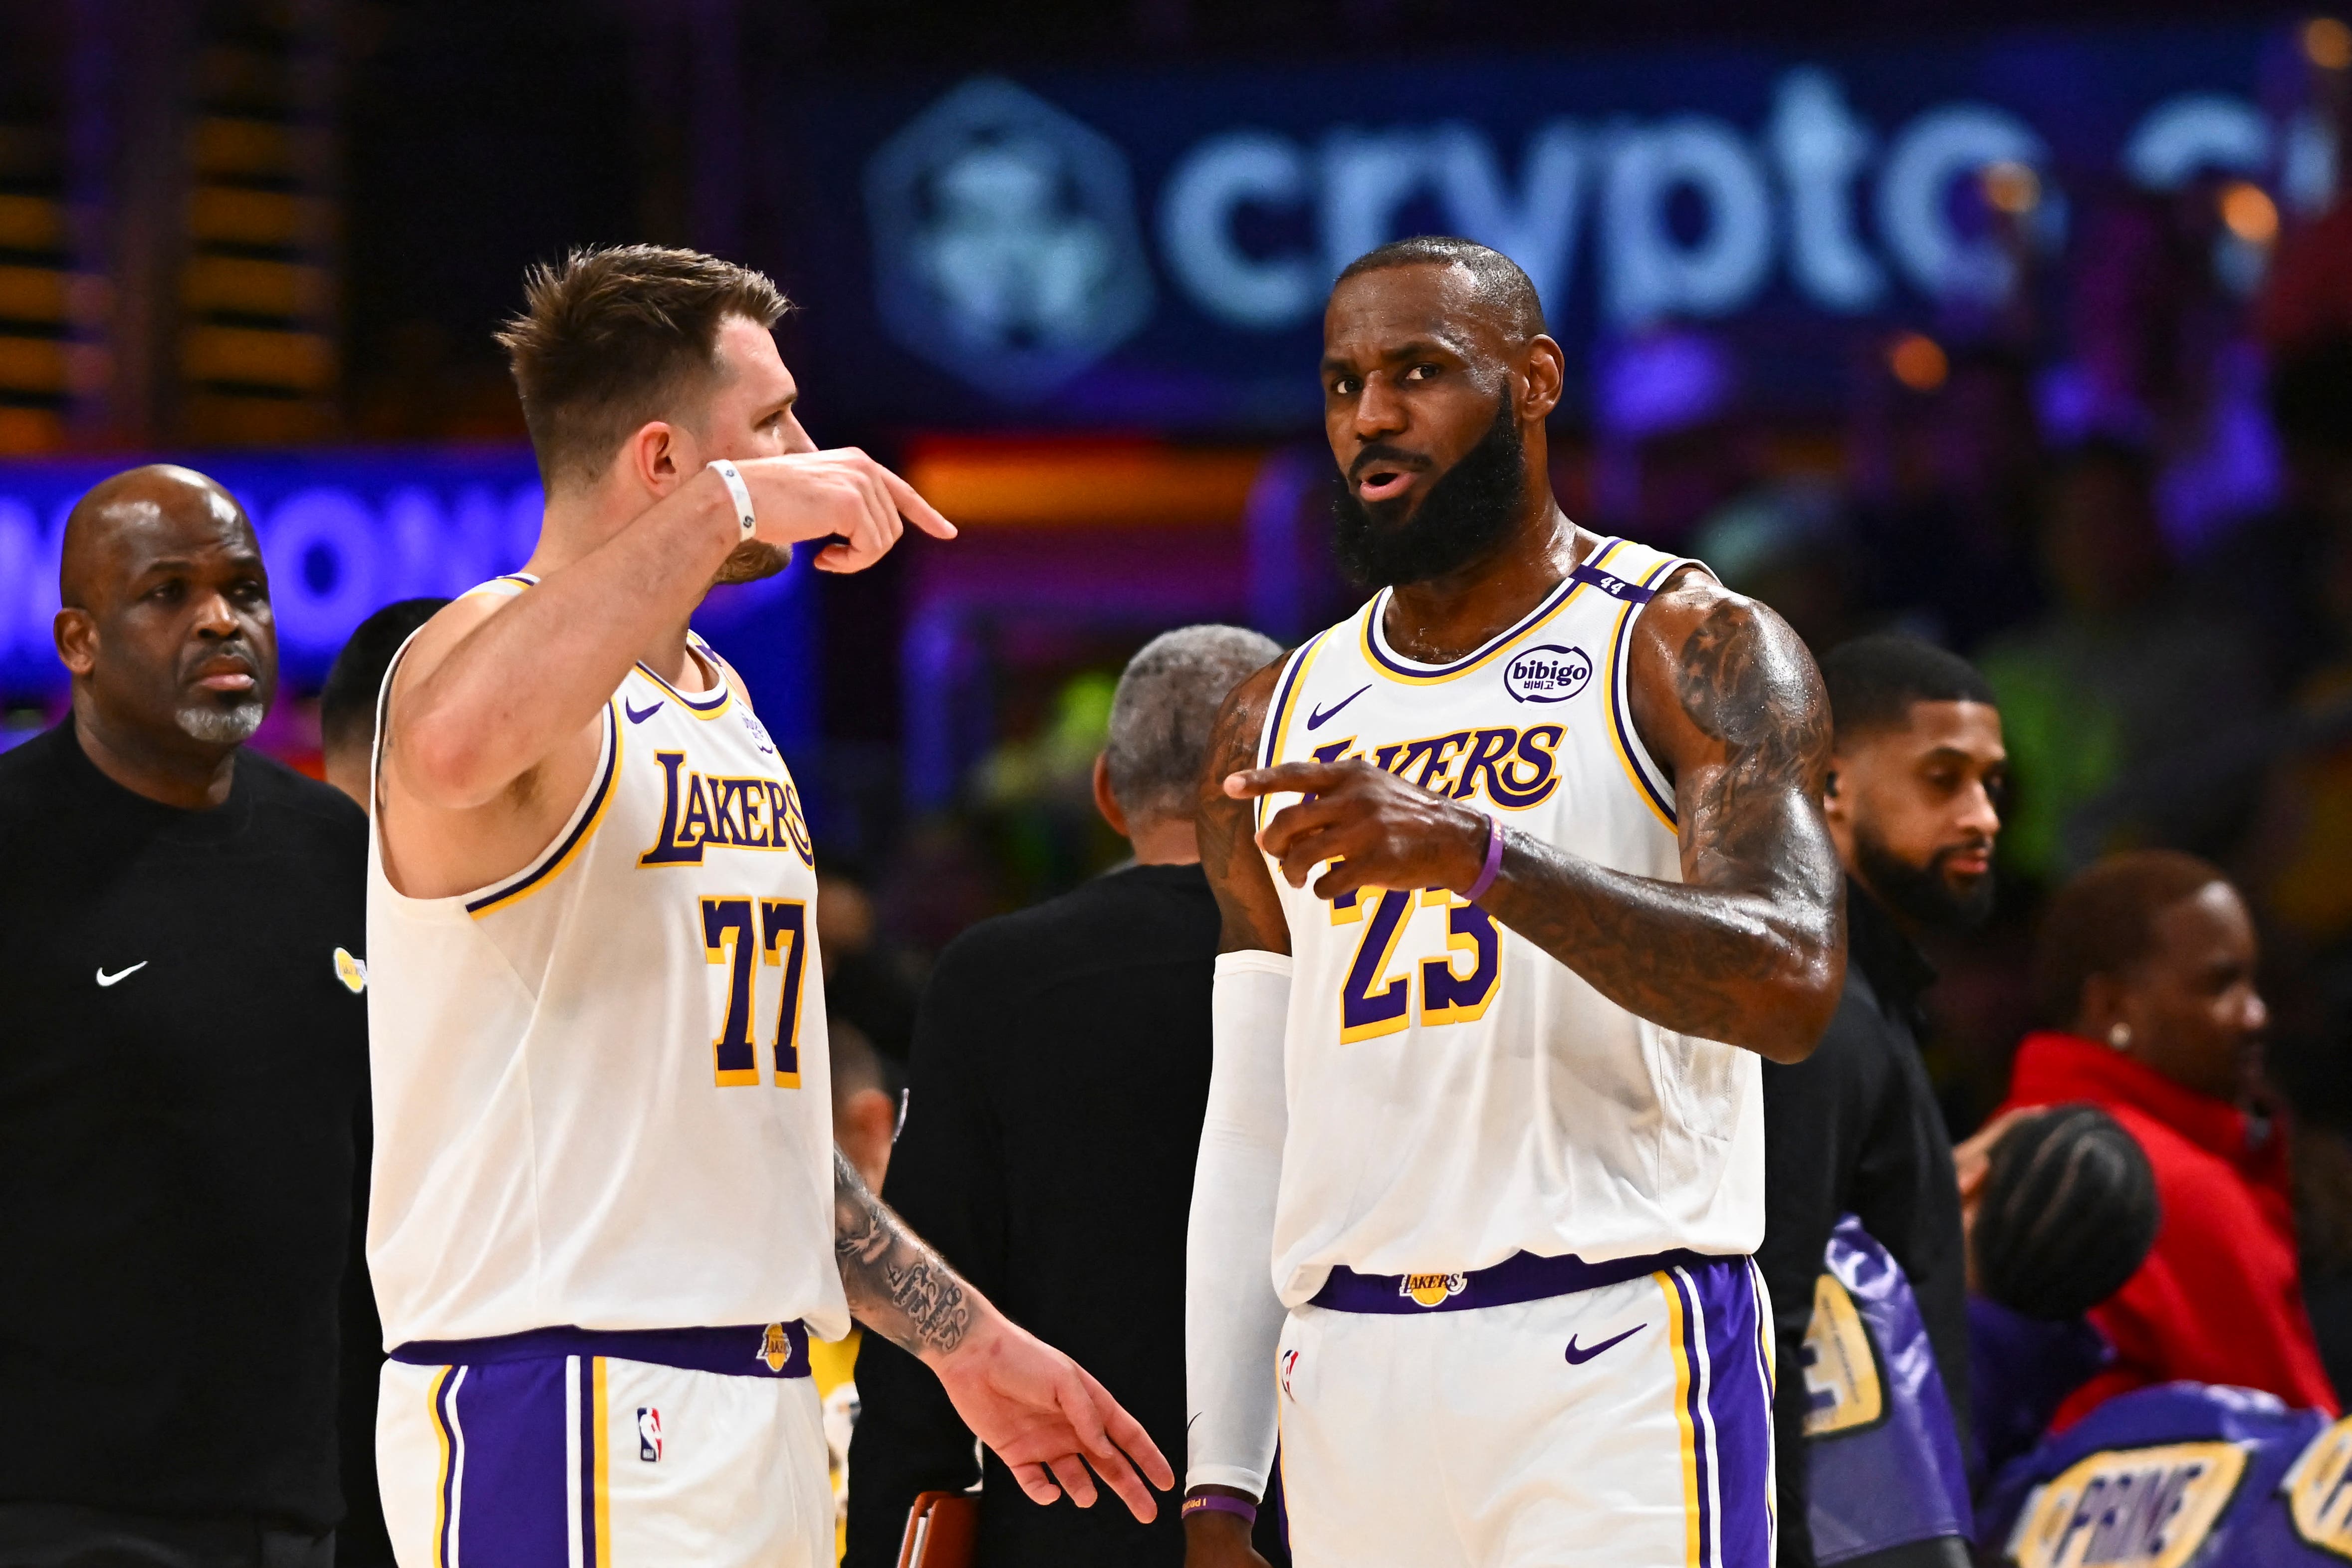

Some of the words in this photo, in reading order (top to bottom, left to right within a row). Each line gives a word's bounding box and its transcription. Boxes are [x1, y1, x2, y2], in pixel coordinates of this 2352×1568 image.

[1600, 577, 1626, 595] 44
[1513, 660, 1587, 686] bibigo
[1523, 680, 1554, 690] 비비고
[1300, 722, 1568, 811] KERS
[636, 749, 815, 871] LAKERS
[1324, 854, 1502, 1044] 23
[699, 895, 807, 1089] 77
[1399, 1273, 1467, 1296] LAKERS
